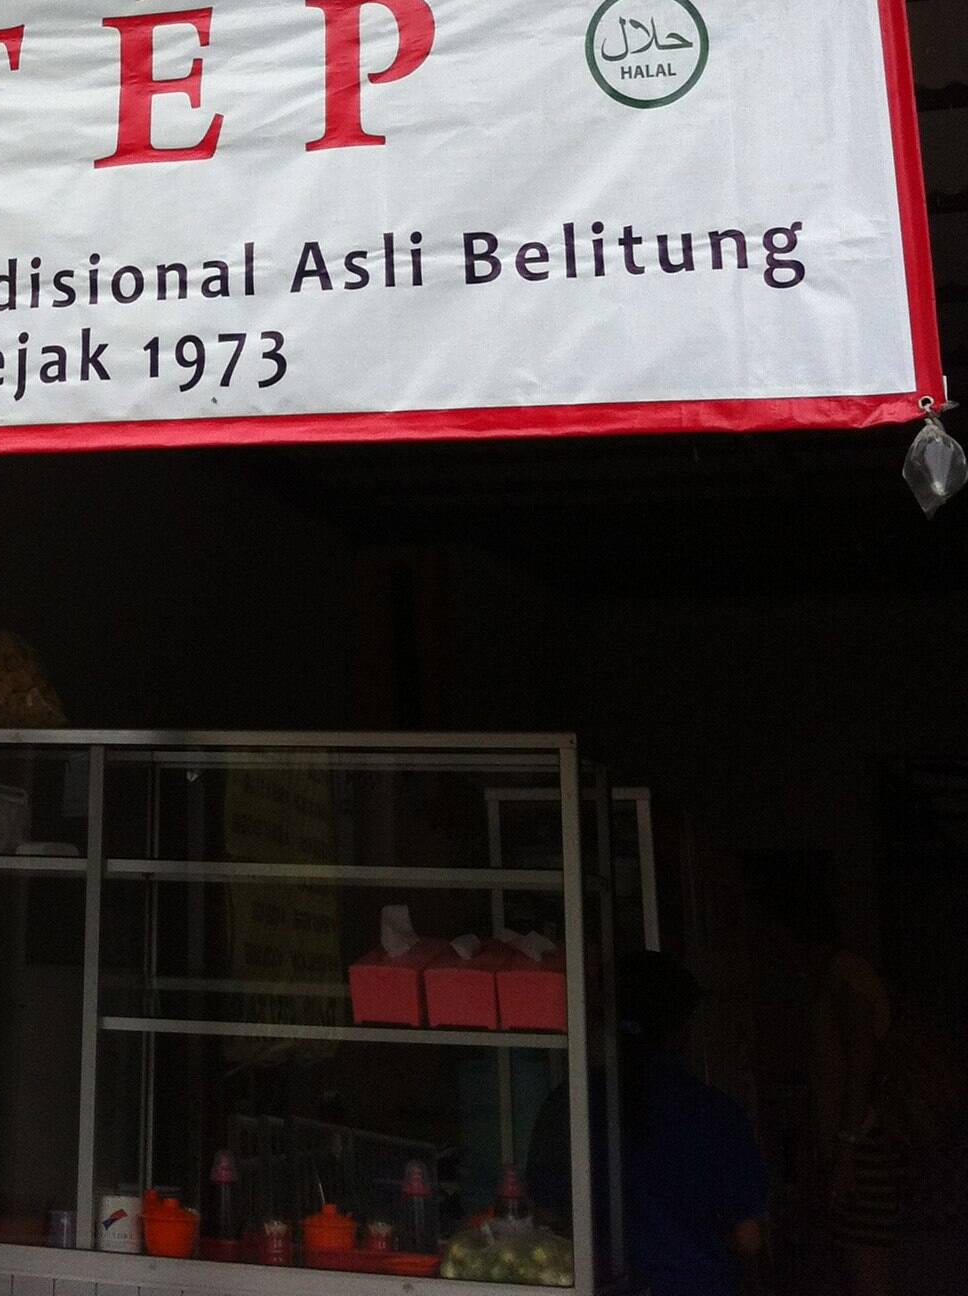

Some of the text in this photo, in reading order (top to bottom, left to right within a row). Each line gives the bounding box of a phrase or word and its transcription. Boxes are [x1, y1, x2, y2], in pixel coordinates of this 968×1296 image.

[601, 16, 694, 62] حلال
[620, 63, 677, 80] HALAL
[290, 231, 423, 293] Asli
[462, 221, 806, 289] Belitung
[143, 330, 288, 393] 1973
